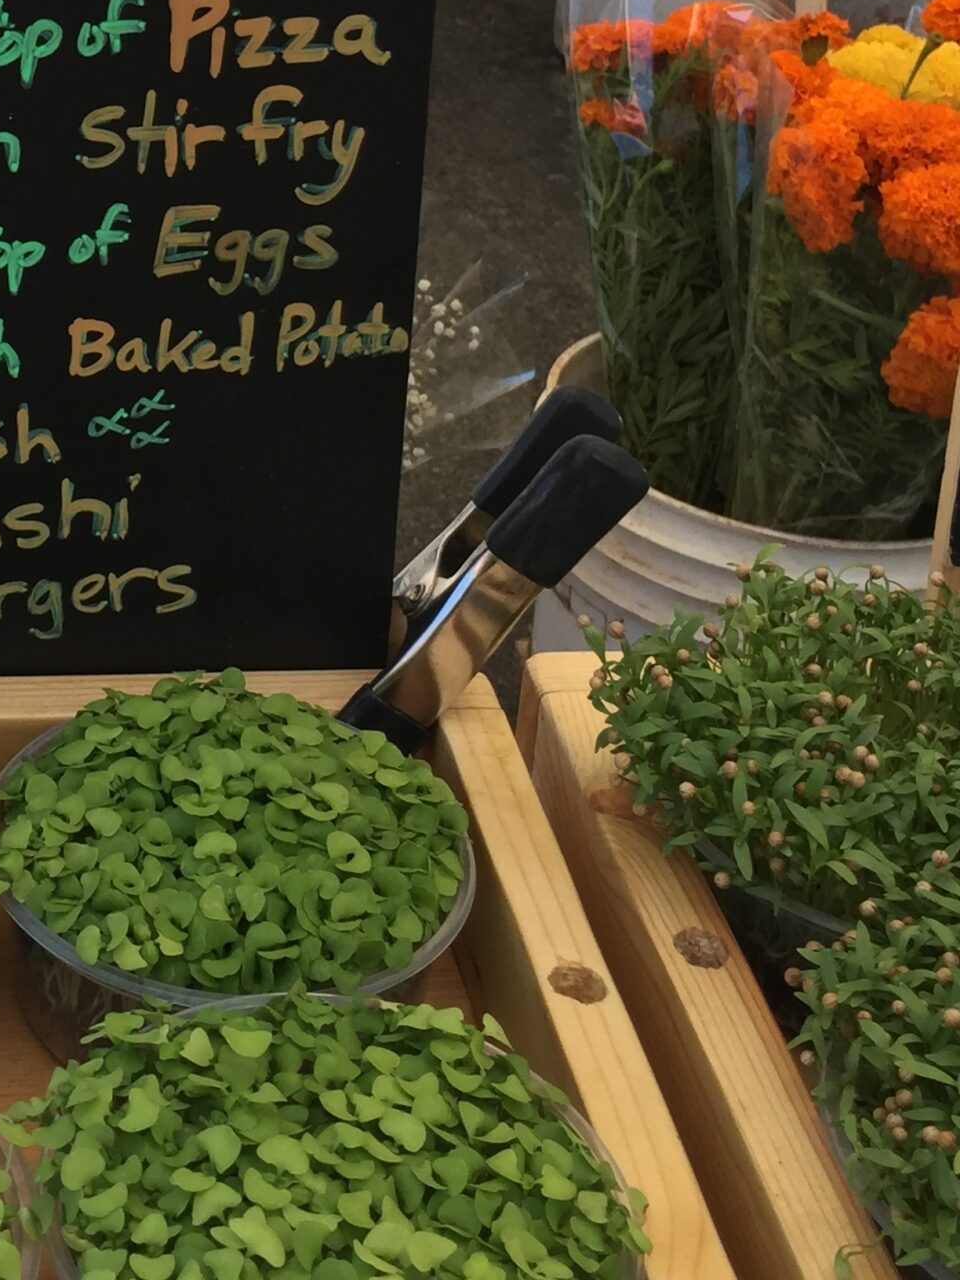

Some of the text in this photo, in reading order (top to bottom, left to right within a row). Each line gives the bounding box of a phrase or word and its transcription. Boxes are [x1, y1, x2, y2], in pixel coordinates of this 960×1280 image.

[75, 89, 226, 177] Stir
[237, 85, 365, 205] fry
[69, 203, 131, 265] of
[152, 203, 340, 296] Eggs
[68, 311, 254, 376] Baked
[277, 300, 408, 372] Potato
